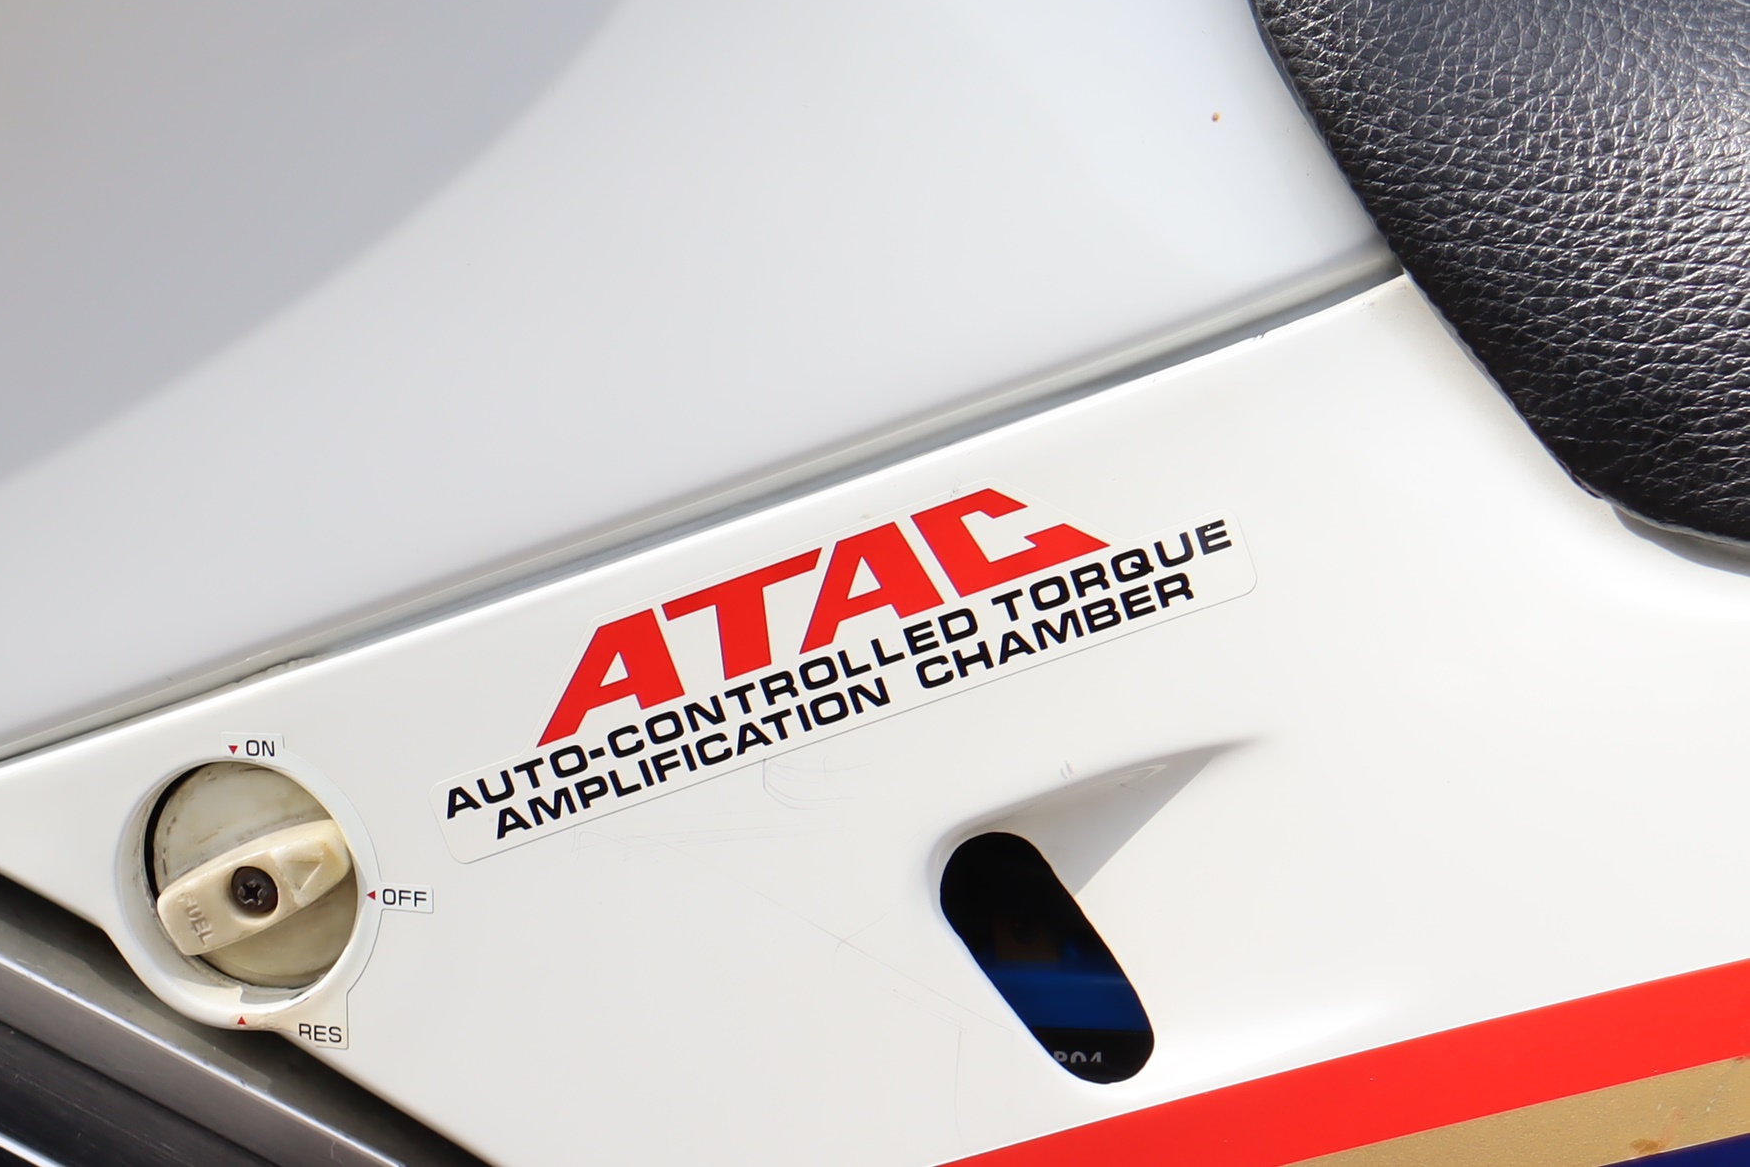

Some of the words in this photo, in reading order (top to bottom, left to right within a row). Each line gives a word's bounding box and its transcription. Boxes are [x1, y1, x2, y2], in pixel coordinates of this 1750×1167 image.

[538, 487, 1111, 748] ATAC
[447, 608, 979, 820] AUTO-CONTROLLED
[990, 519, 1232, 622] TORQUE
[496, 676, 891, 840] AMPLIFICATION
[915, 572, 1194, 689] CHAMBER
[245, 739, 275, 757] ON
[178, 892, 214, 947] FUEL
[382, 888, 428, 908] OFF
[298, 1022, 343, 1044] RES
